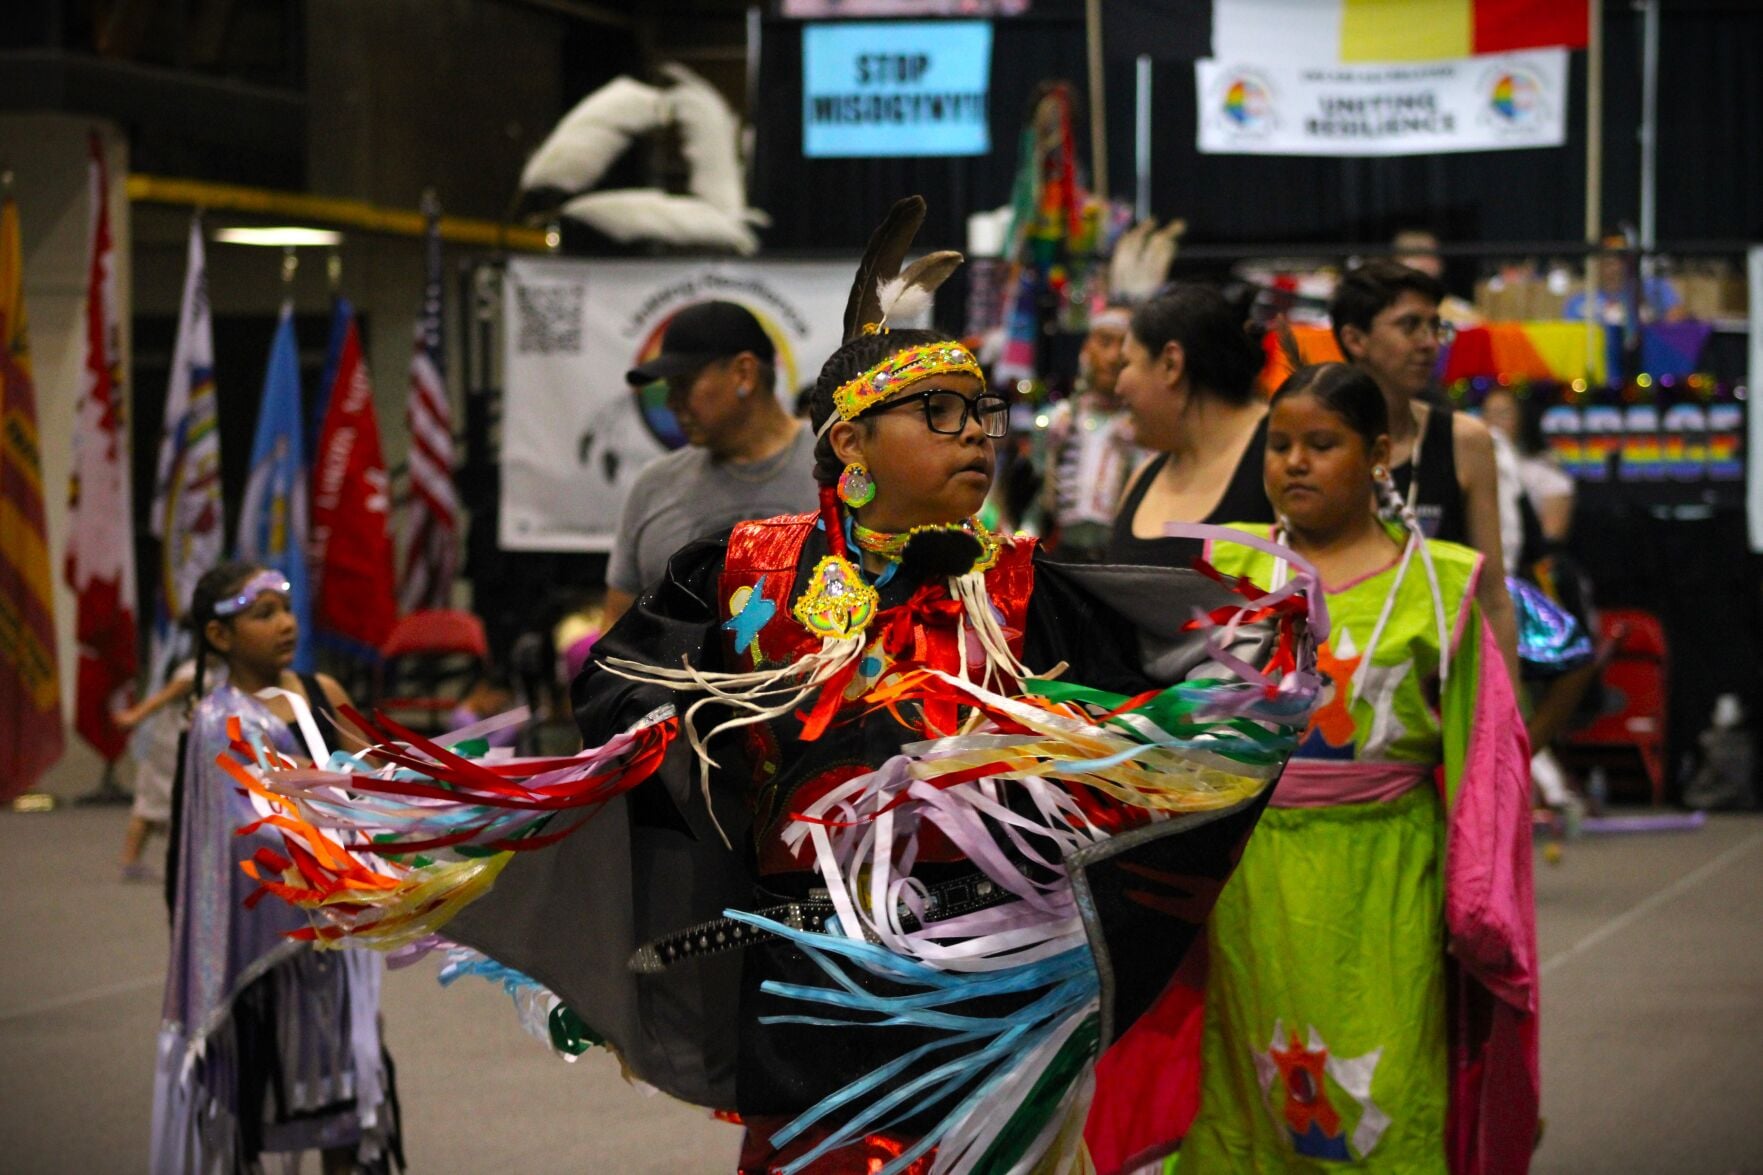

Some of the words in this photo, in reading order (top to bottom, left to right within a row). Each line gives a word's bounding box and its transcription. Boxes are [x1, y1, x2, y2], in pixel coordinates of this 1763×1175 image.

[856, 54, 929, 85] STOP
[1318, 93, 1436, 117] UNITING
[1304, 115, 1455, 137] RESILIENCE
